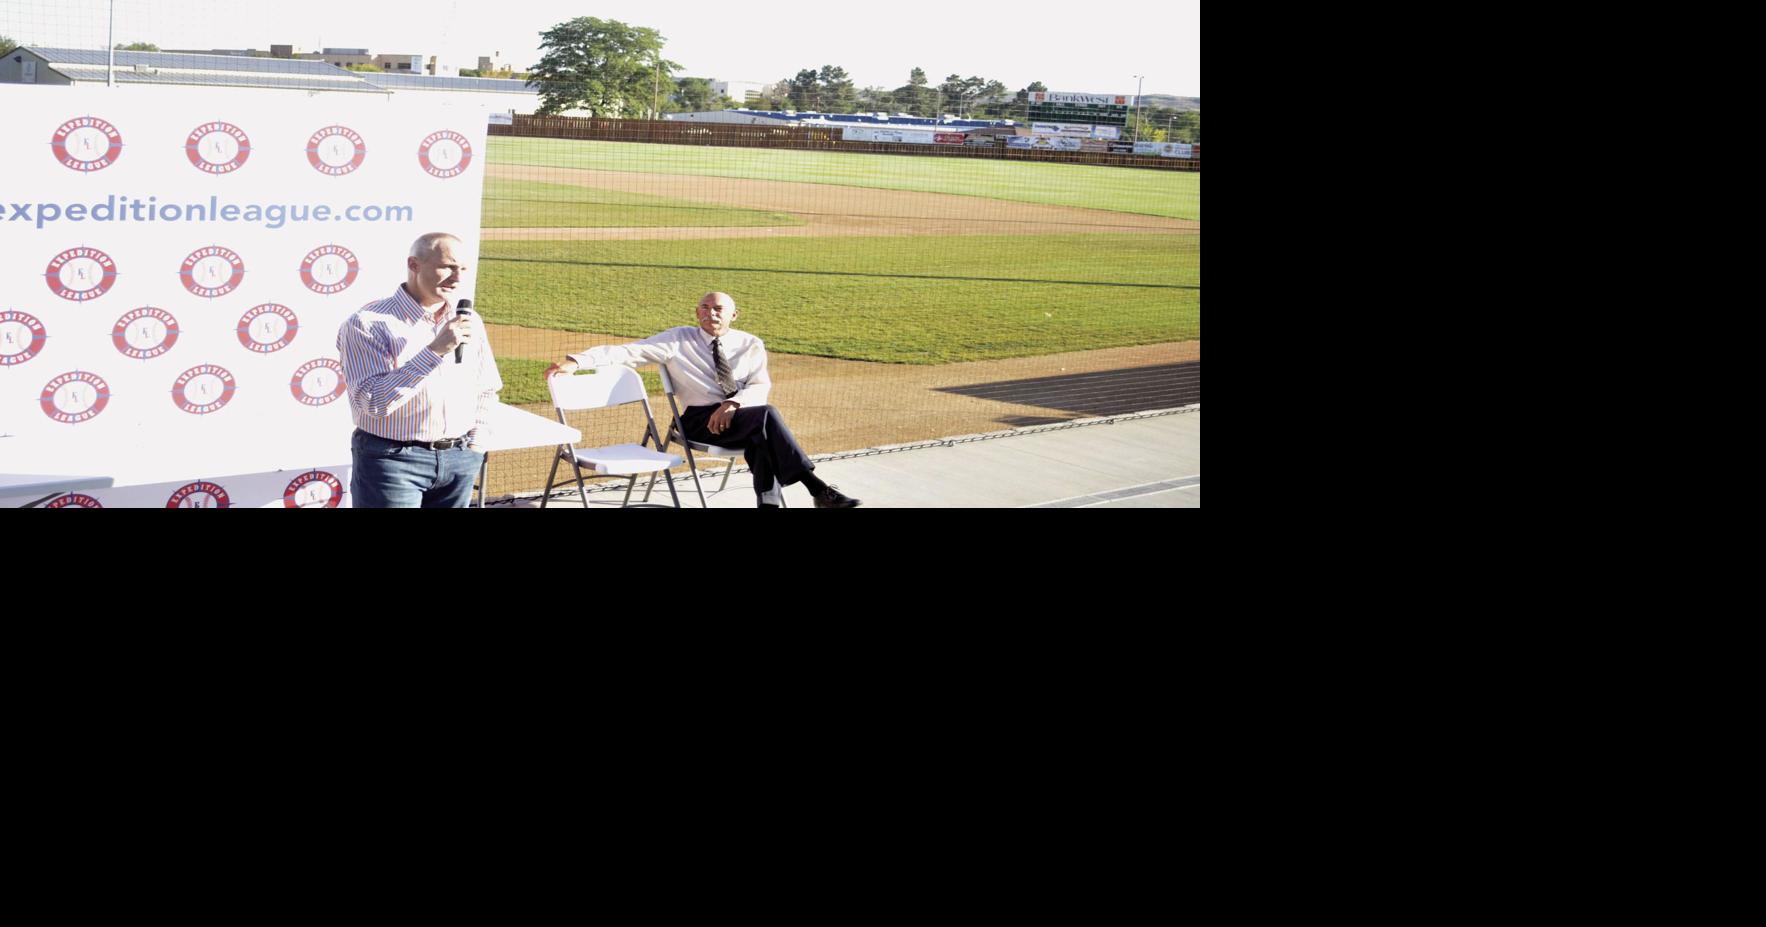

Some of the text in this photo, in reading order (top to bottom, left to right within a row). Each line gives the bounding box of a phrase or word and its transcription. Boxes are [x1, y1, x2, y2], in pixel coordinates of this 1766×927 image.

[1049, 93, 1108, 104] BankWest
[57, 118, 117, 138] EXPEDITION
[191, 123, 246, 142] EXPEDITION
[311, 127, 361, 146] EXPEDITION
[422, 131, 469, 149] EXPEDITION
[66, 158, 109, 170] LEAGUE
[198, 162, 238, 173] LEAGUE
[318, 164, 354, 175] LEAGUE
[428, 167, 461, 177] LEAGUE
[0, 195, 414, 229] xpeditionleague.com
[50, 248, 112, 268] EXPEDITION
[185, 248, 240, 266] EXPEDITION
[305, 246, 355, 264] EXPEDITION
[60, 288, 102, 300] LEAGUE
[192, 286, 232, 298] LEAGUE
[311, 282, 347, 294] LEAGUE
[0, 313, 42, 330] EDITION
[118, 308, 175, 328] EXPEDITION
[242, 304, 295, 324] EXPEDITION
[125, 346, 166, 359] LEAGUE
[248, 340, 286, 352] LEAGUE
[0, 352, 32, 364] AGUE
[46, 372, 106, 392] EXPEDITION
[178, 366, 232, 386] EXPEDITION
[184, 400, 222, 413] LEAGUE
[54, 410, 96, 423] LEAGUE
[288, 472, 340, 492] EXPEDITION
